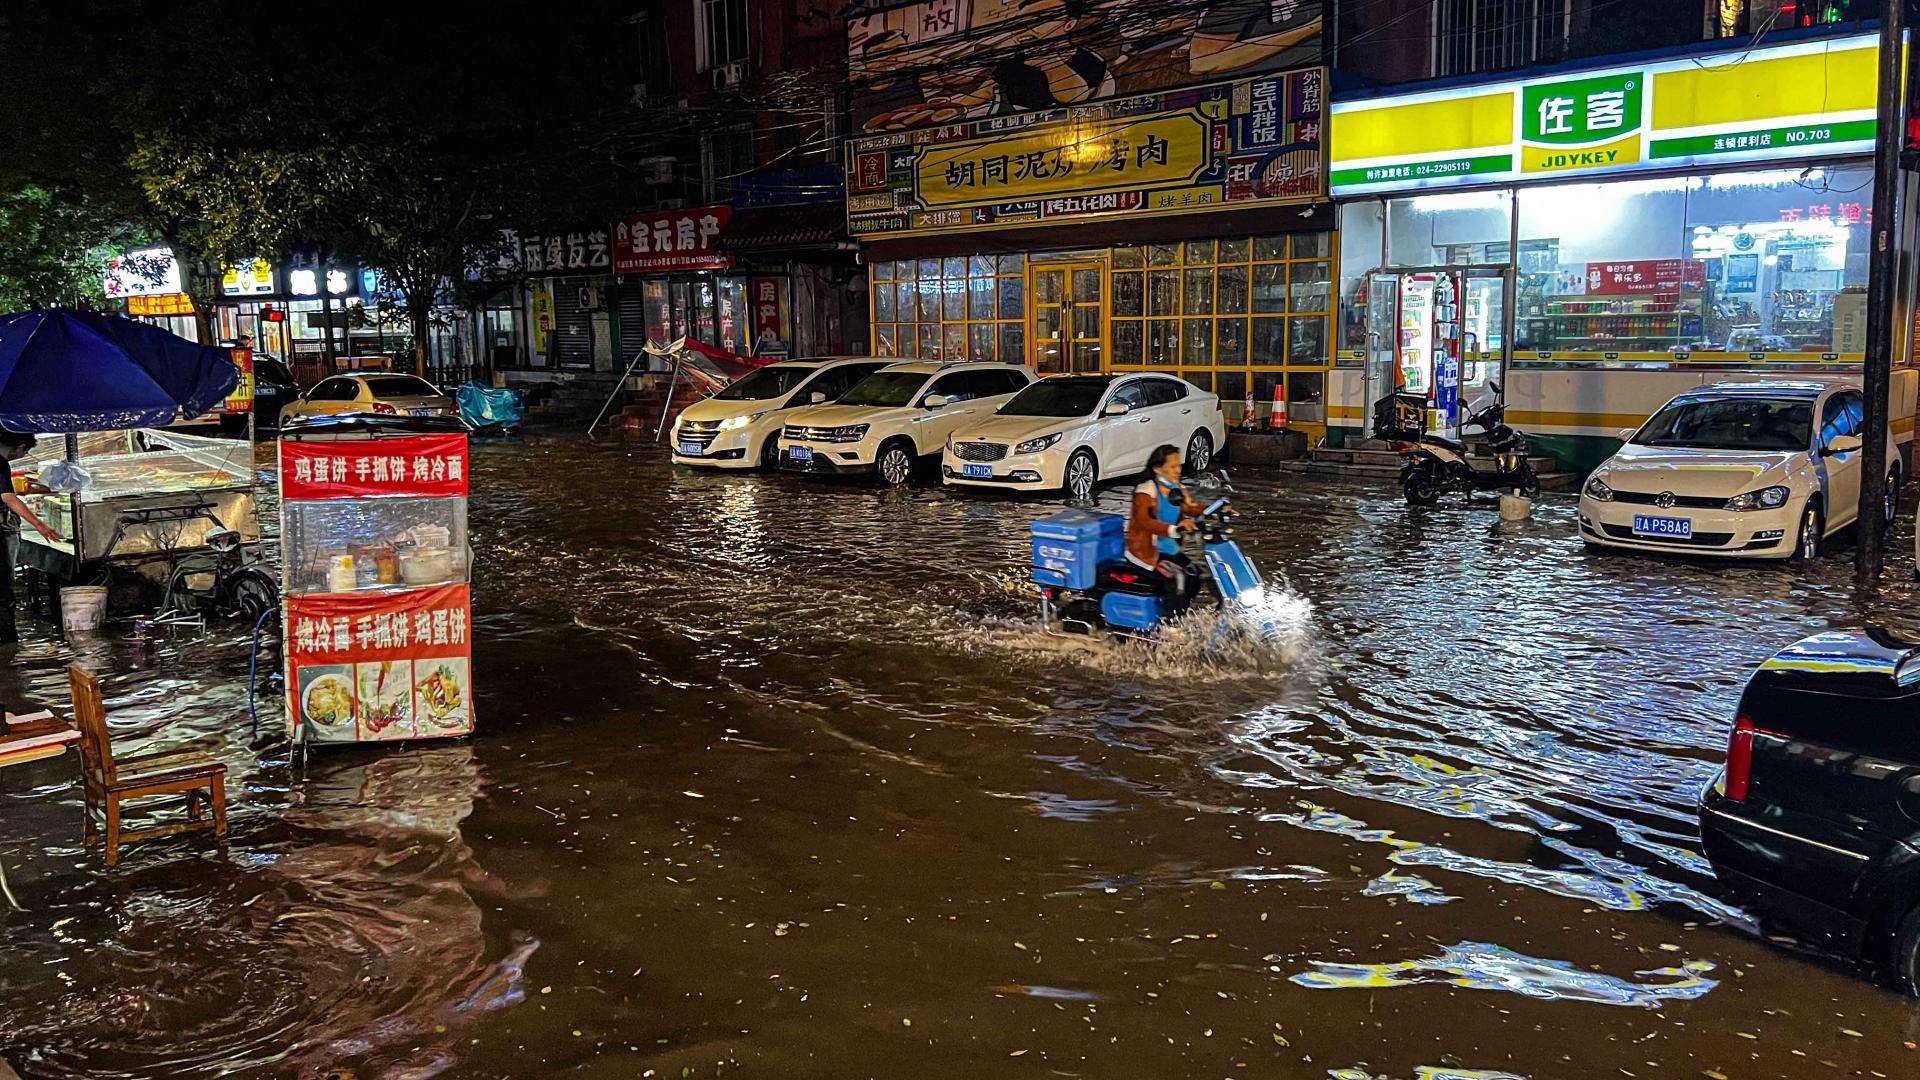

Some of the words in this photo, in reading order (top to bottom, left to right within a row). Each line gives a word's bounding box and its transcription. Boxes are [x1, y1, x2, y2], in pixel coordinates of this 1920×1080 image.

[1252, 81, 1277, 143] 老式拌饭
[1537, 90, 1625, 136] 佐客
[1713, 134, 1772, 150] 连锁便利店
[1785, 129, 1831, 143] NO.703
[864, 156, 880, 186] 冷面
[1541, 149, 1618, 168] JOYKEY
[1046, 194, 1117, 214] 烤五花肉
[1157, 191, 1213, 207] 烤羊肉
[631, 213, 720, 254] 宝元房产
[294, 456, 348, 483] 鸡蛋饼
[354, 455, 406, 482] 手抓饼
[412, 454, 463, 482] 烤冷面
[295, 616, 351, 654] 烤冷面
[356, 611, 410, 650] 手抓饼
[414, 607, 467, 646] 鸡蛋饼
